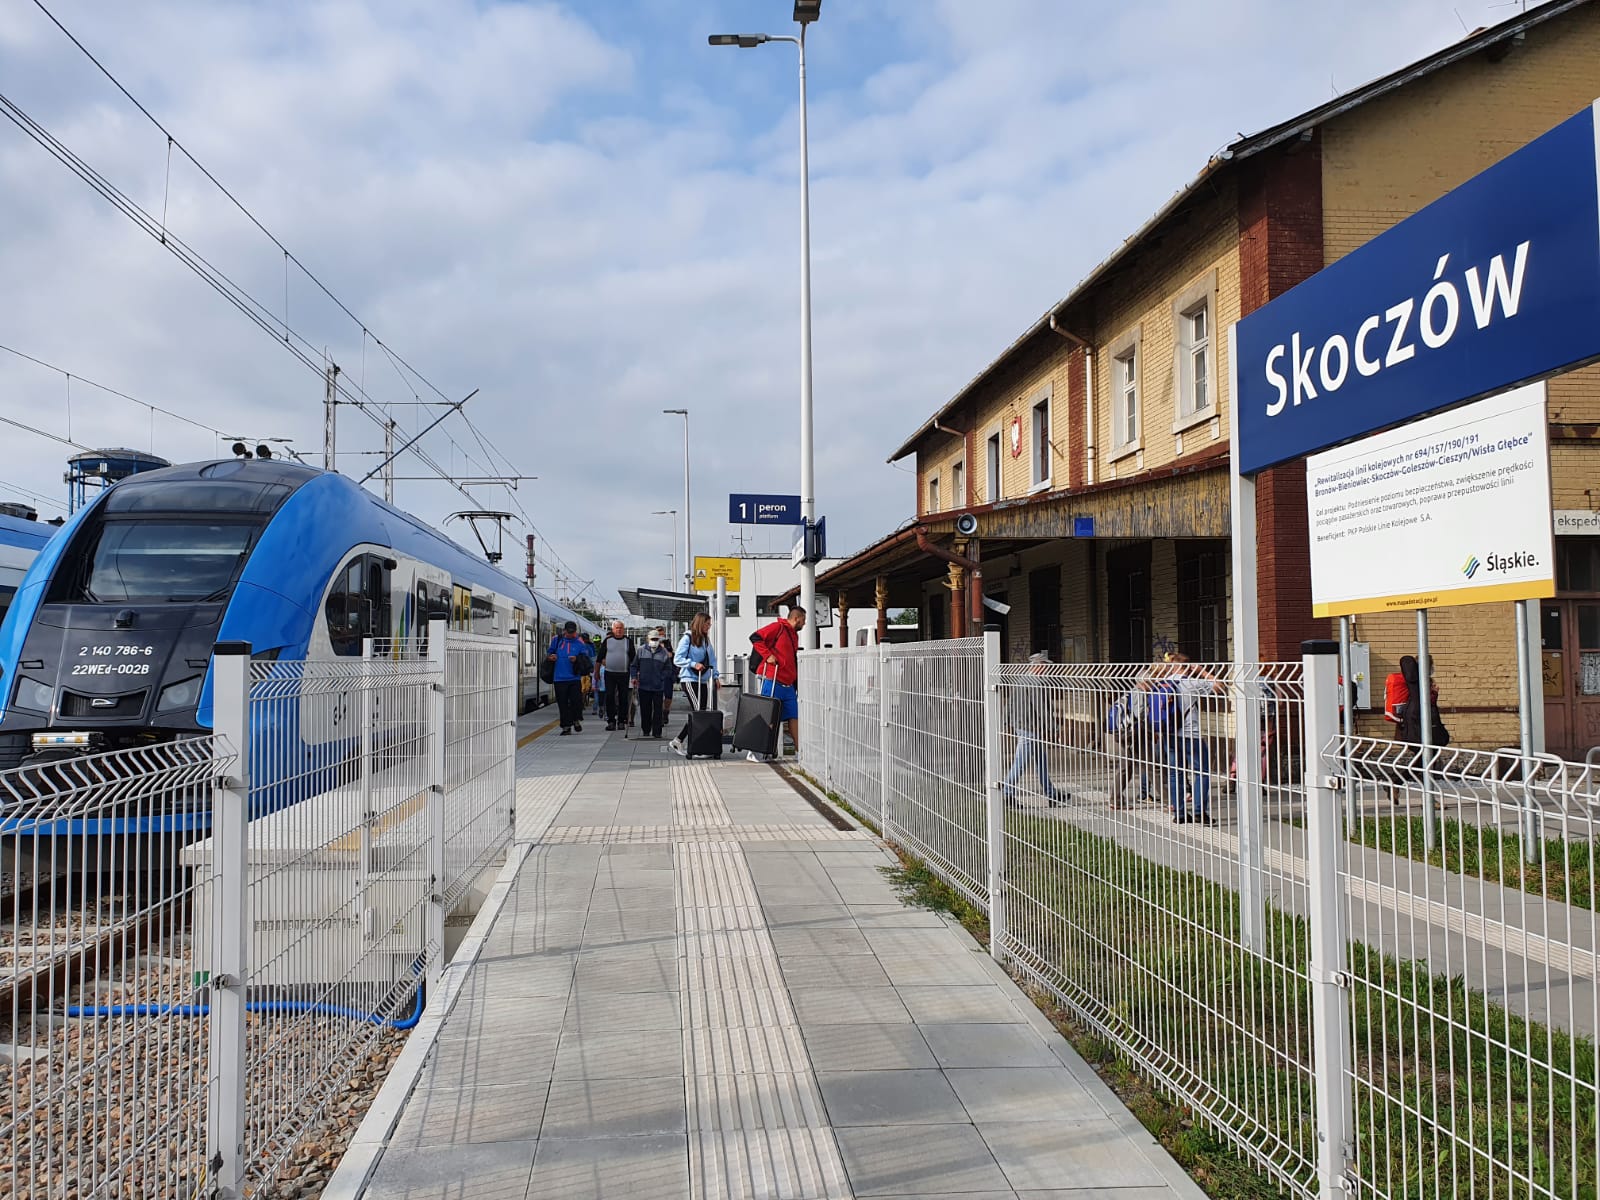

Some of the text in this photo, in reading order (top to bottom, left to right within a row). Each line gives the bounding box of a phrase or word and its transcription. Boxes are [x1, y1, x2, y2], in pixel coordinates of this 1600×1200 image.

[1265, 240, 1530, 417] Skoczów
[1367, 454, 1404, 472] kolejowych
[1405, 453, 1413, 462] nr
[1414, 433, 1479, 460] 694/157/190/191
[1456, 469, 1496, 485] zwiększenie
[1497, 459, 1534, 477] prędkości
[1419, 491, 1446, 505] poprawa
[1447, 479, 1499, 499] przepustowości
[1500, 475, 1514, 488] linii
[739, 502, 787, 519] 1 peron
[1347, 527, 1358, 536] PKP
[1358, 523, 1377, 534] Polskie
[1377, 521, 1391, 531] Linie
[1391, 515, 1418, 528] Kolejowe
[1420, 513, 1433, 522] S.A.
[1486, 551, 1540, 574] Śląskie.
[78, 645, 153, 656] 2 140 786-6
[71, 664, 150, 675] 22WEd-002B
